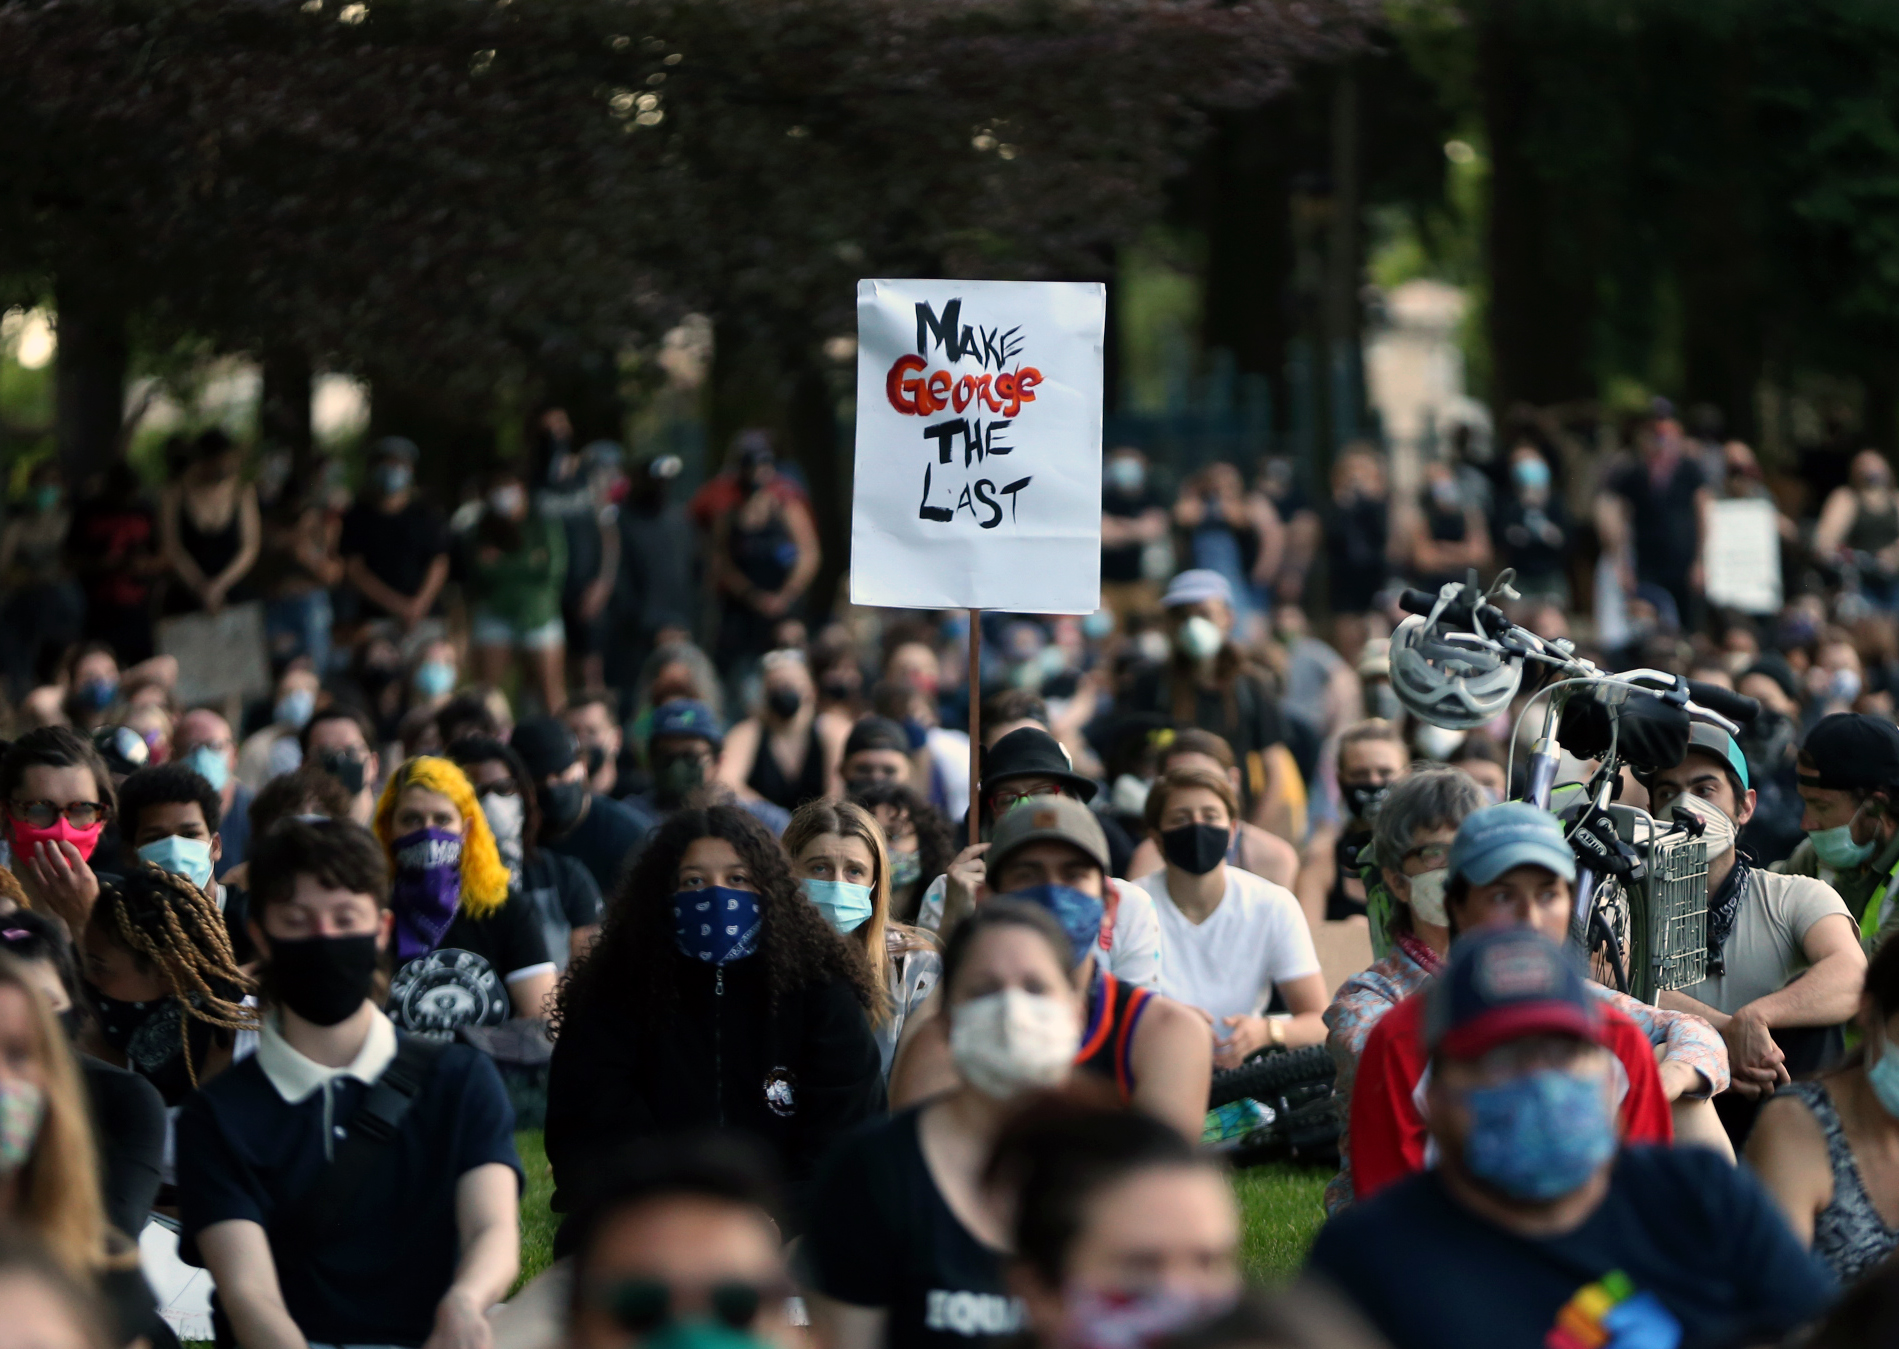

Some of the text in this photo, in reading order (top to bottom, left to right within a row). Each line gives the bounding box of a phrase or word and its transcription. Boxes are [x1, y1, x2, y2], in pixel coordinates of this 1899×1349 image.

[915, 297, 1025, 371] MAKE
[923, 417, 1015, 468] THE
[919, 462, 1034, 529] LAST
